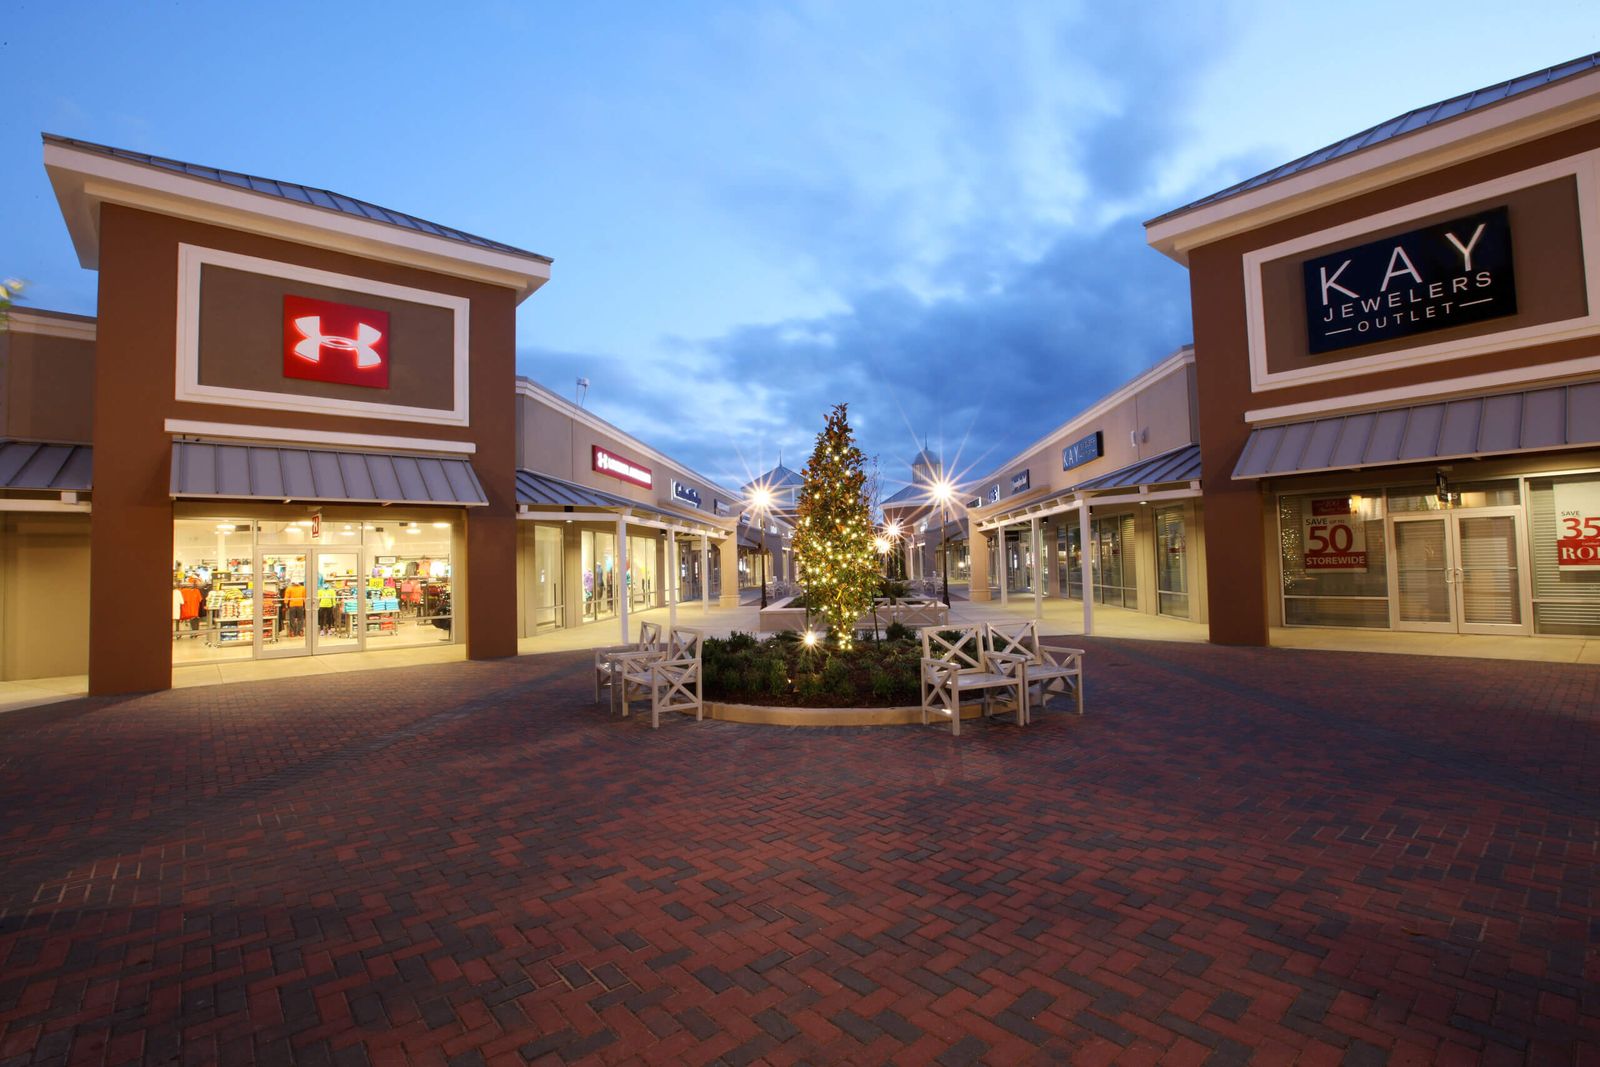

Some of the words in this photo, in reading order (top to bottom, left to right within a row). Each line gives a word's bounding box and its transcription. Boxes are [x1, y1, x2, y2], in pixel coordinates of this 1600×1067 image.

[1320, 223, 1486, 305] KAY
[1323, 271, 1492, 322] JEWELERS
[1358, 302, 1453, 332] OUTLET
[1063, 446, 1079, 467] KAY
[1305, 518, 1328, 526] SAVE
[1562, 517, 1600, 540] 35
[1309, 524, 1353, 554] 50
[1306, 555, 1366, 565] STOREWIDE
